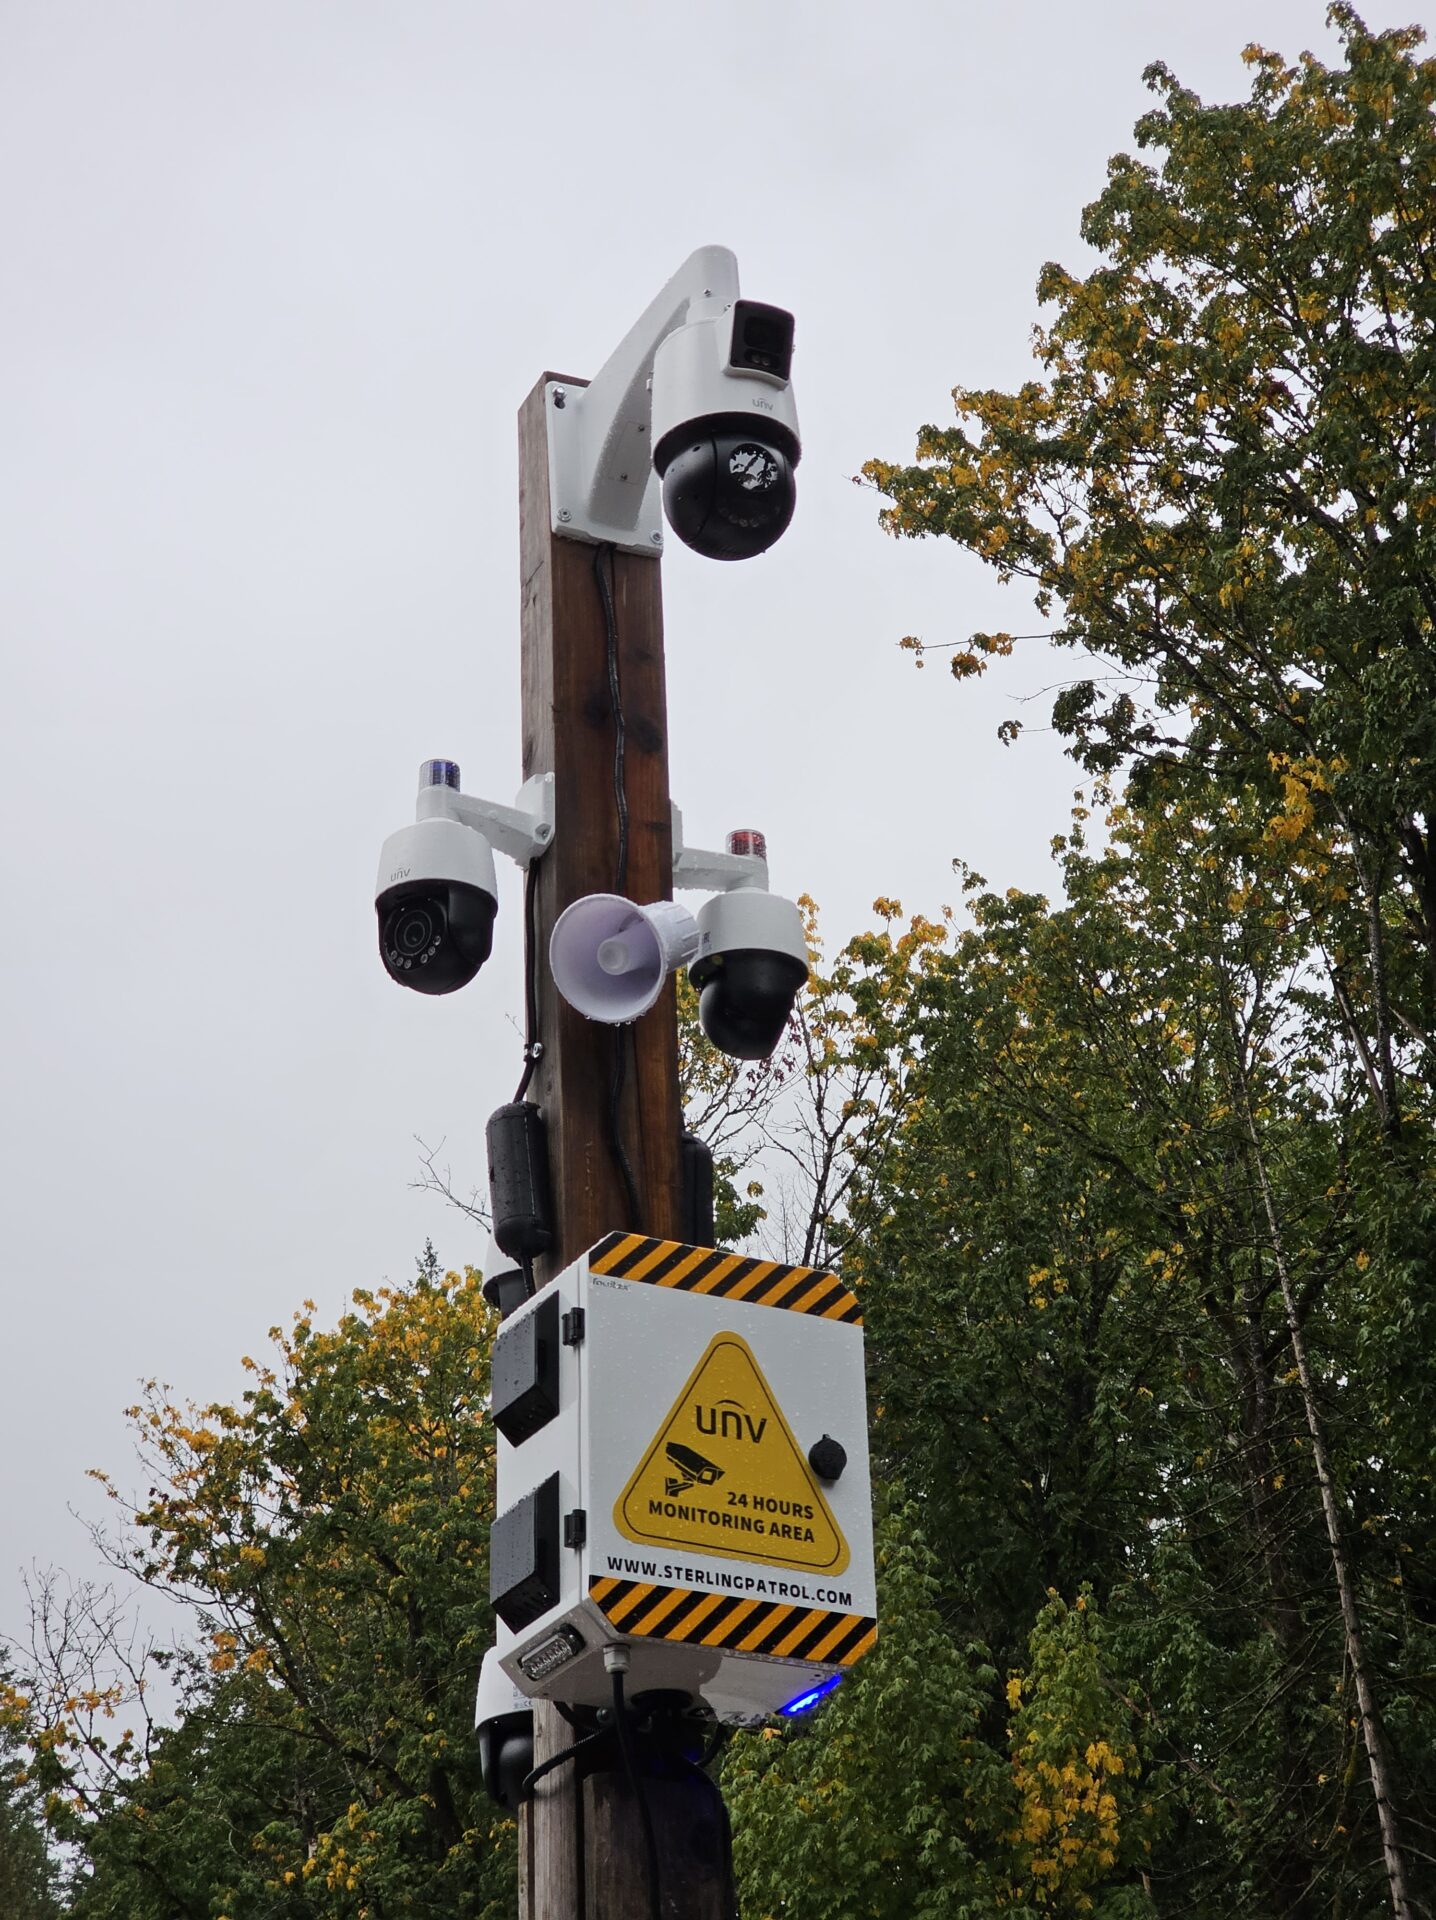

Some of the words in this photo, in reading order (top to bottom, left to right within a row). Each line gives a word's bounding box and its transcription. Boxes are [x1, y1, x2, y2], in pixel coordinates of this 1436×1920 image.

[752, 398, 773, 410] unv
[391, 867, 411, 881] unv
[695, 1400, 767, 1444] unv
[649, 1500, 765, 1535] MONITORING
[769, 1521, 815, 1543] AREA
[727, 1491, 748, 1508] 24
[753, 1495, 815, 1520] HOURS
[607, 1556, 852, 1606] WWW.STERLINGPATROL.COM
